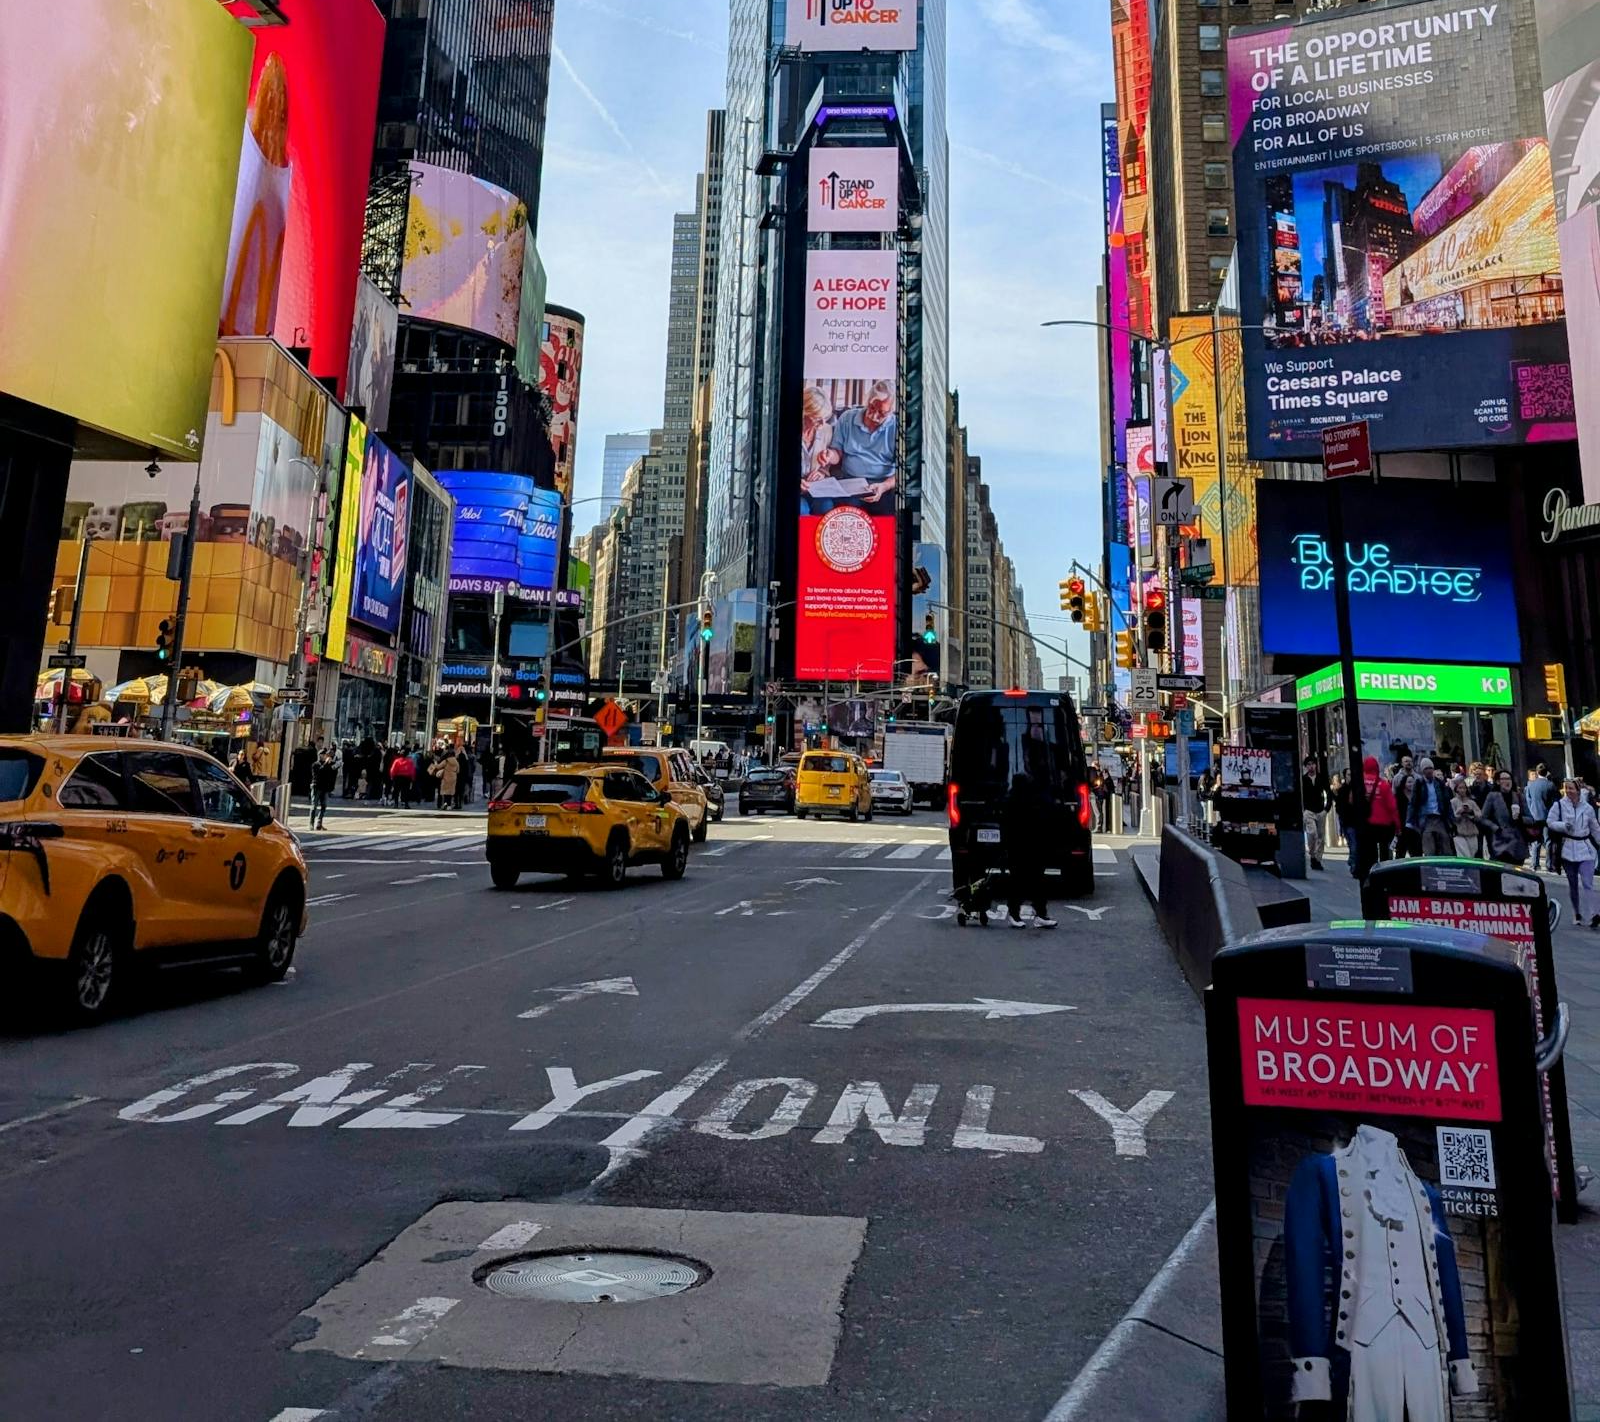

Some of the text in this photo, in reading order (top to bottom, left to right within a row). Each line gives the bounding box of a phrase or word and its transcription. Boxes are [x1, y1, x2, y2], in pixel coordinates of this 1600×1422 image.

[830, 9, 899, 24] CANCER
[1249, 4, 1498, 69] THE OPPORTUNITY
[1250, 42, 1433, 93] OF A LIFETIME
[1252, 70, 1434, 114] FOR LOCAL BUSINESSES
[1253, 101, 1371, 133] FOR BROADWAY
[1254, 124, 1364, 153] FOR ALL OF US
[1254, 128, 1493, 172] ENTERTAINMENT LIVE SPORTSBOOK 5-STAR HOTEL
[838, 180, 874, 190] STAND
[838, 198, 887, 209] CANCER
[813, 278, 890, 292] A LEGACY
[816, 297, 886, 310] OF HOPE
[822, 319, 877, 329] Advancing
[828, 330, 870, 342] the Fight
[812, 343, 889, 354] Against Cancer
[1264, 357, 1334, 376] We Support
[1266, 368, 1402, 393] Caesars Palace
[492, 375, 509, 436] 1500
[1267, 388, 1389, 411] Times Square
[1184, 412, 1206, 423] THE
[1474, 408, 1493, 416] SCAN
[1489, 414, 1509, 422] CODE
[1334, 427, 1360, 441] STOPPING
[1326, 442, 1349, 455] Anytime
[1161, 512, 1189, 522] ONLY
[547, 591, 568, 603] IOL
[1185, 679, 1199, 687] WAY
[1360, 673, 1438, 691] FRIENDS
[1136, 687, 1155, 699] 25
[1222, 747, 1272, 758] CHICAGO
[1389, 900, 1532, 918] JAM BAD MONEY
[1458, 919, 1535, 936] CRIMINAL
[1254, 1014, 1479, 1055] MUSEUM OF
[1256, 1050, 1481, 1093] BROADWAY
[1279, 1089, 1305, 1098] WEST
[1327, 1091, 1362, 1100] STREET
[692, 1076, 1178, 1156] ONLY
[1441, 1189, 1497, 1203] SCAN FOR
[1442, 1199, 1498, 1217] TICKETS
